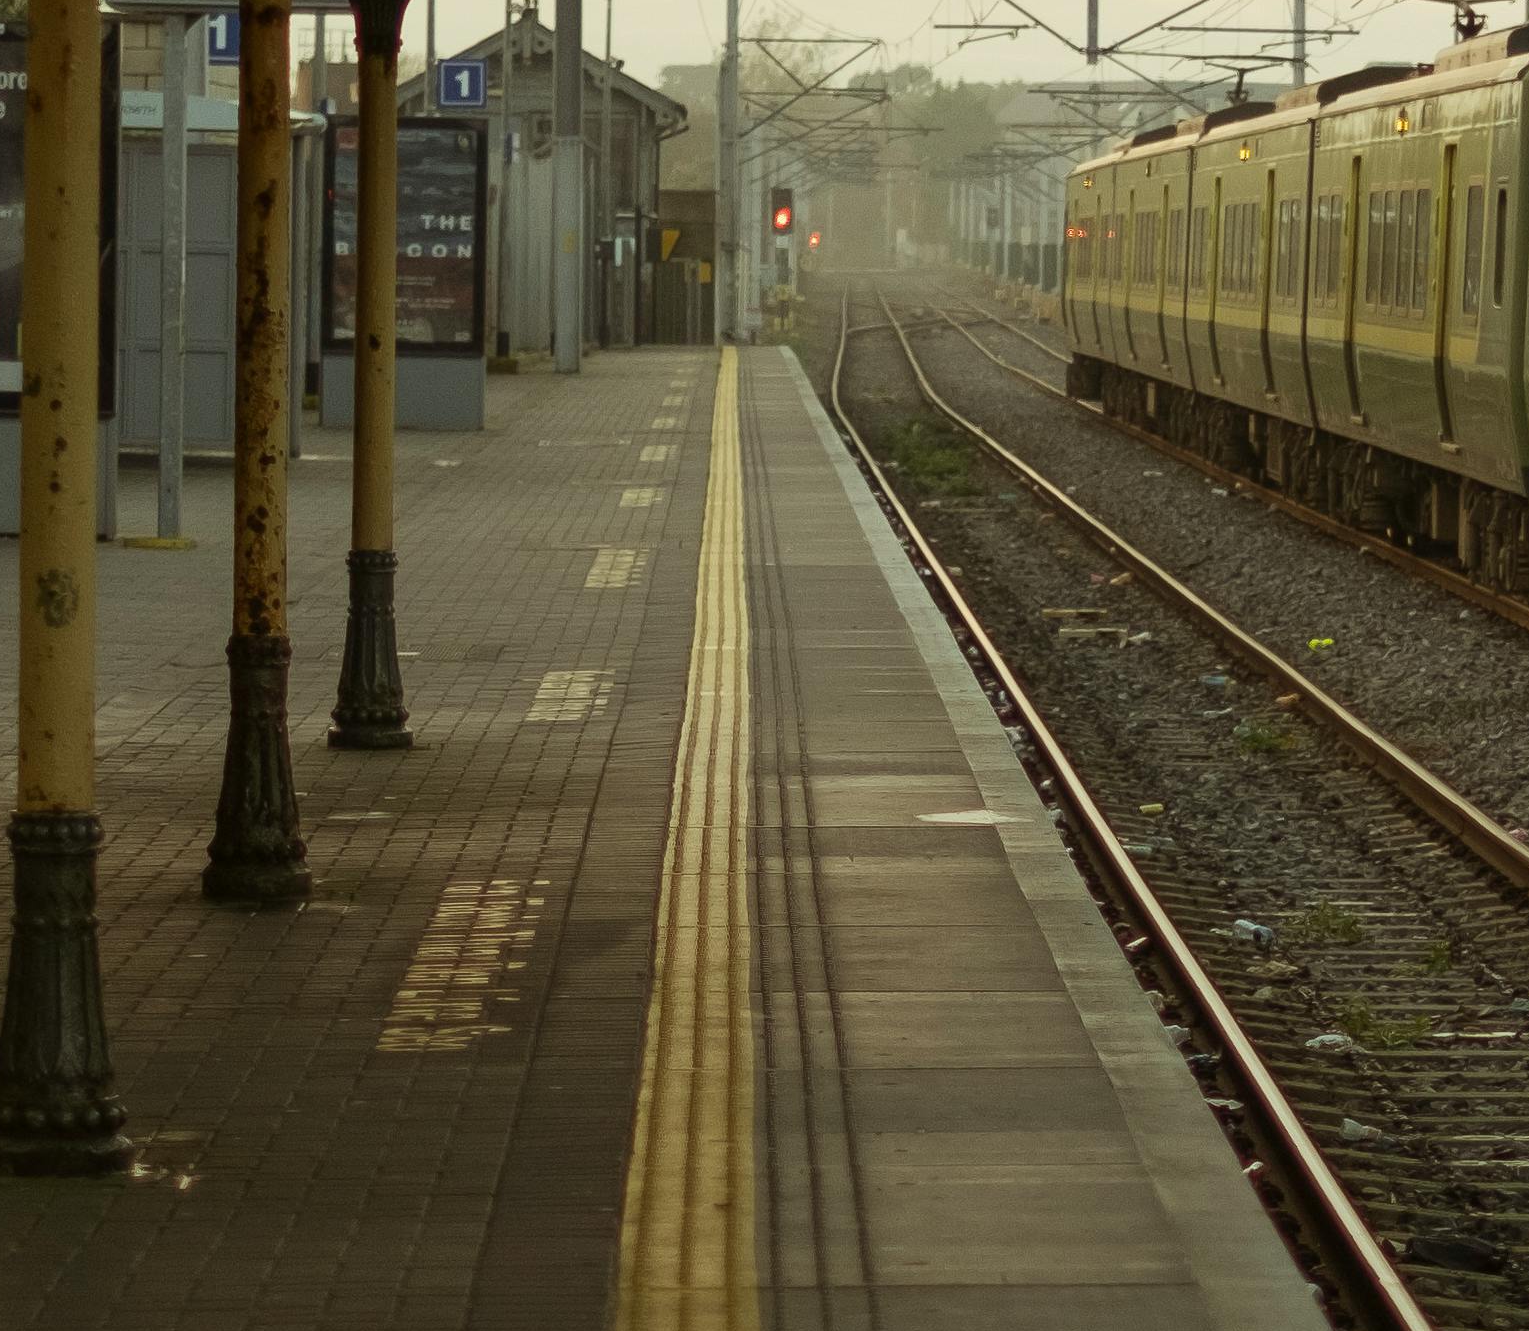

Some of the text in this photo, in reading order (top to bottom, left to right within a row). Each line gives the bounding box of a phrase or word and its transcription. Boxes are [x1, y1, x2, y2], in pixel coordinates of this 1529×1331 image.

[208, 14, 227, 50] 1
[454, 69, 470, 99] 1
[420, 214, 473, 232] THE
[335, 242, 473, 259] BCON
